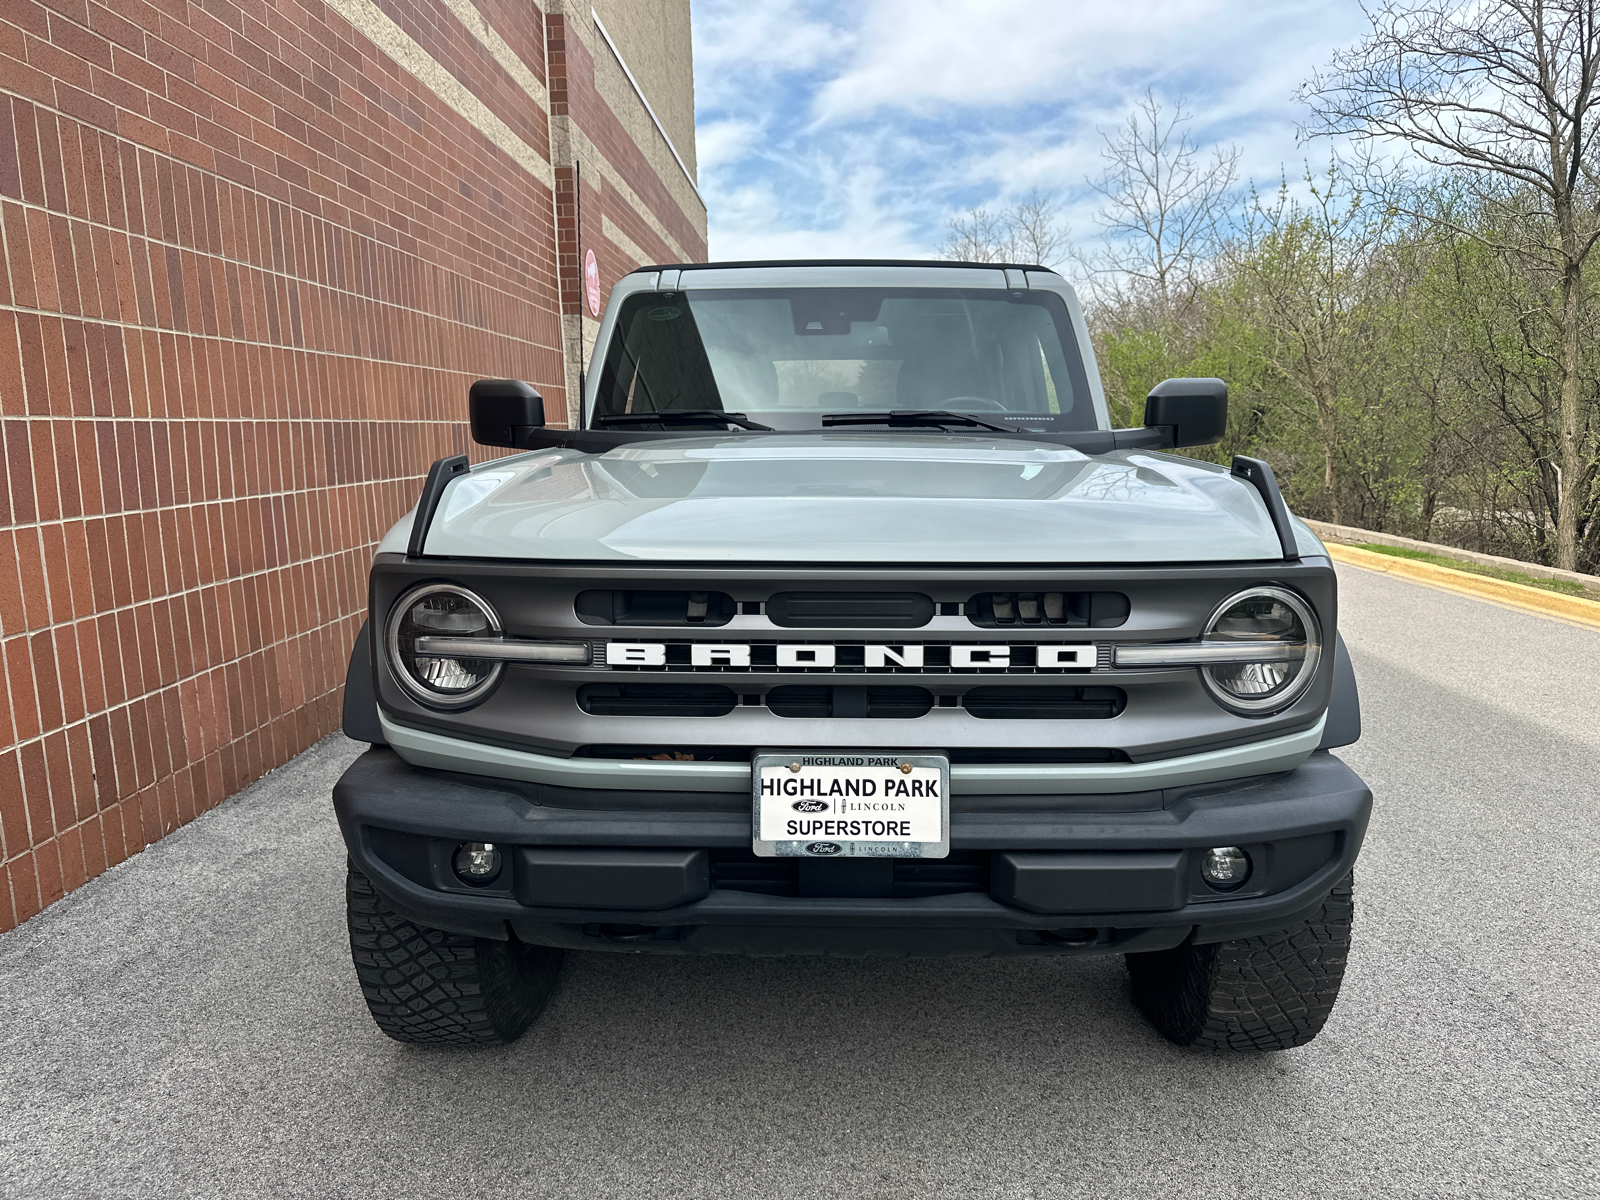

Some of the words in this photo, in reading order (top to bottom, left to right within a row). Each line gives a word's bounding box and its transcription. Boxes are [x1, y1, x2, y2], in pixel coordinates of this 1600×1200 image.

[606, 642, 1098, 668] BRONCO
[803, 757, 864, 766] HIGHLAND
[868, 757, 898, 766] PARK
[761, 778, 877, 797] HIGHLAND
[884, 779, 939, 797] PARK
[850, 803, 906, 811] LINCOLN
[786, 820, 911, 836] SUPERSTORE
